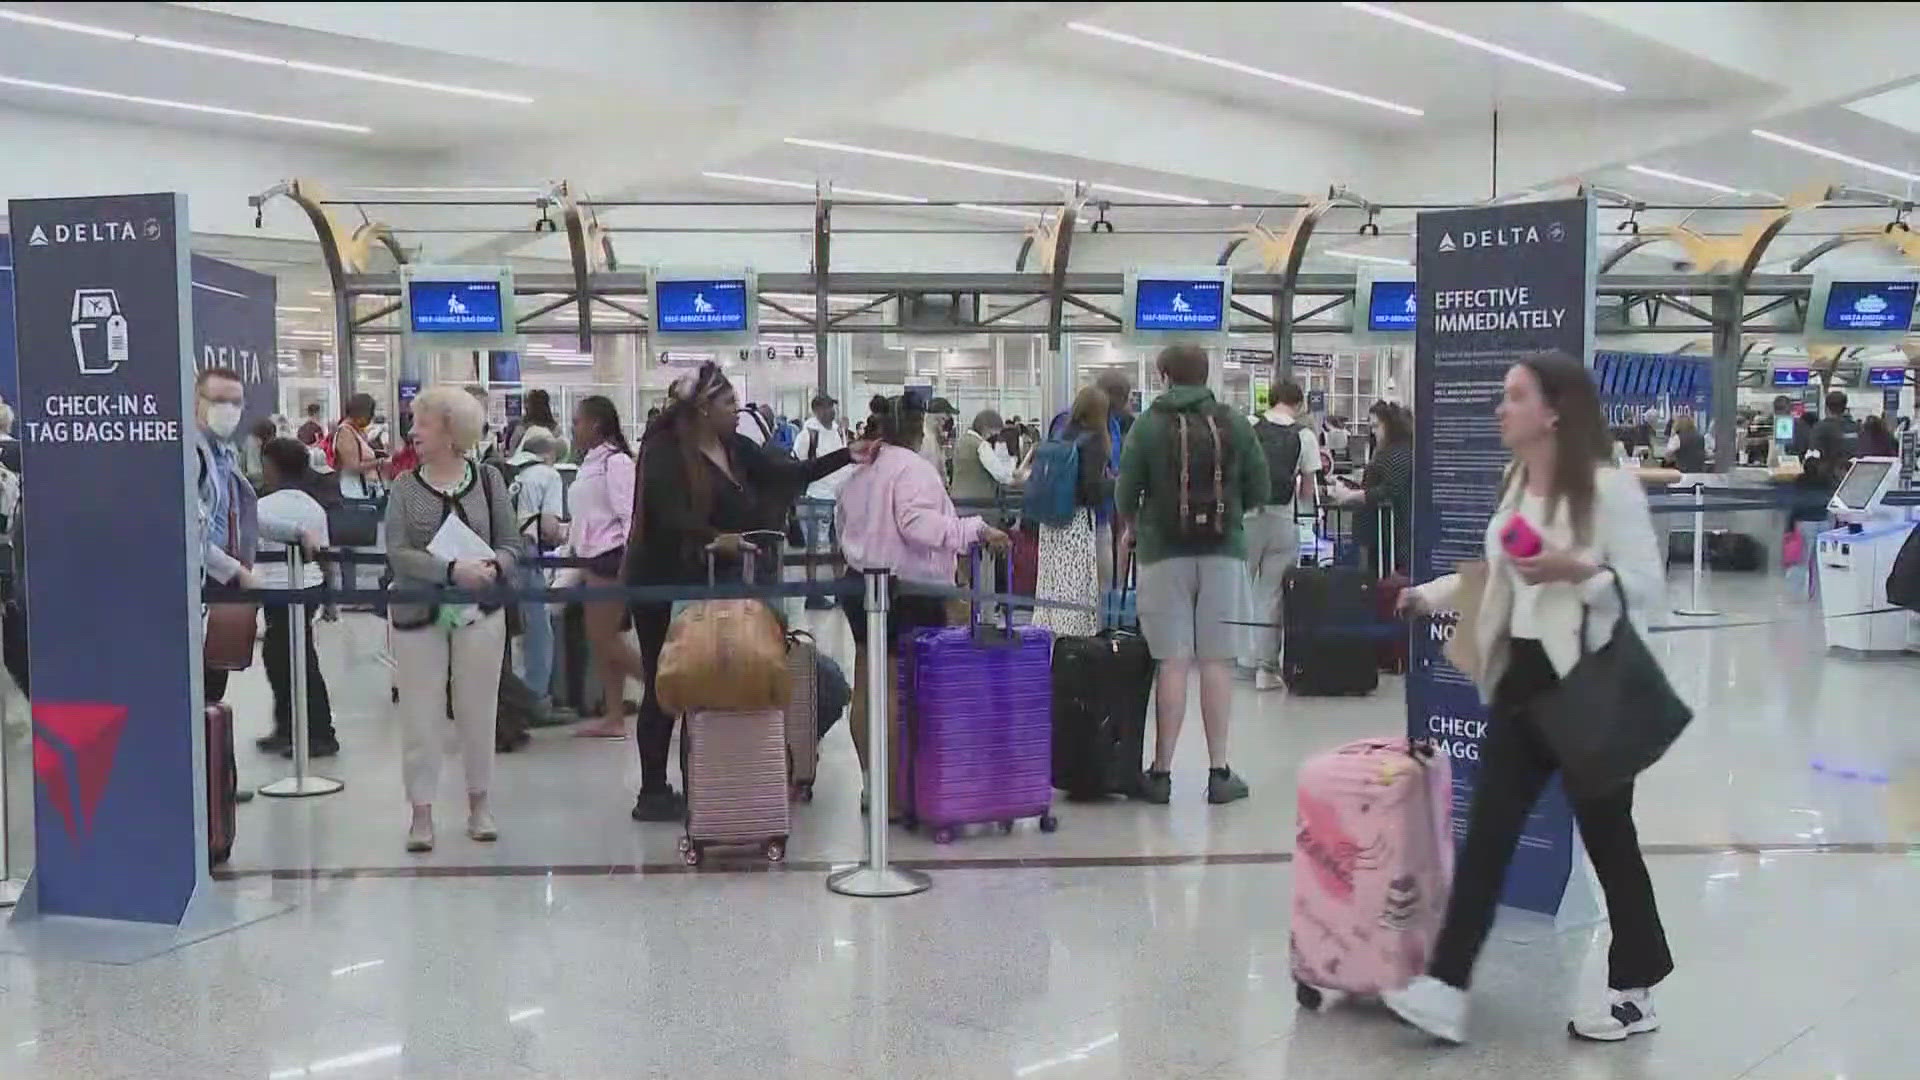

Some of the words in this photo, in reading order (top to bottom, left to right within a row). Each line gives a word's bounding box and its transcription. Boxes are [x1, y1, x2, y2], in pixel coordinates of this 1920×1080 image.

[55, 221, 137, 243] DELTA
[1463, 225, 1540, 249] DELTA
[1434, 287, 1530, 310] EFFECTIVE
[1434, 308, 1566, 333] IMMEDIATELY
[45, 395, 138, 417] CHECK-IN
[142, 394, 158, 416] &
[26, 422, 73, 443] TAG
[74, 421, 125, 442] BAGS
[129, 420, 178, 441] HERE
